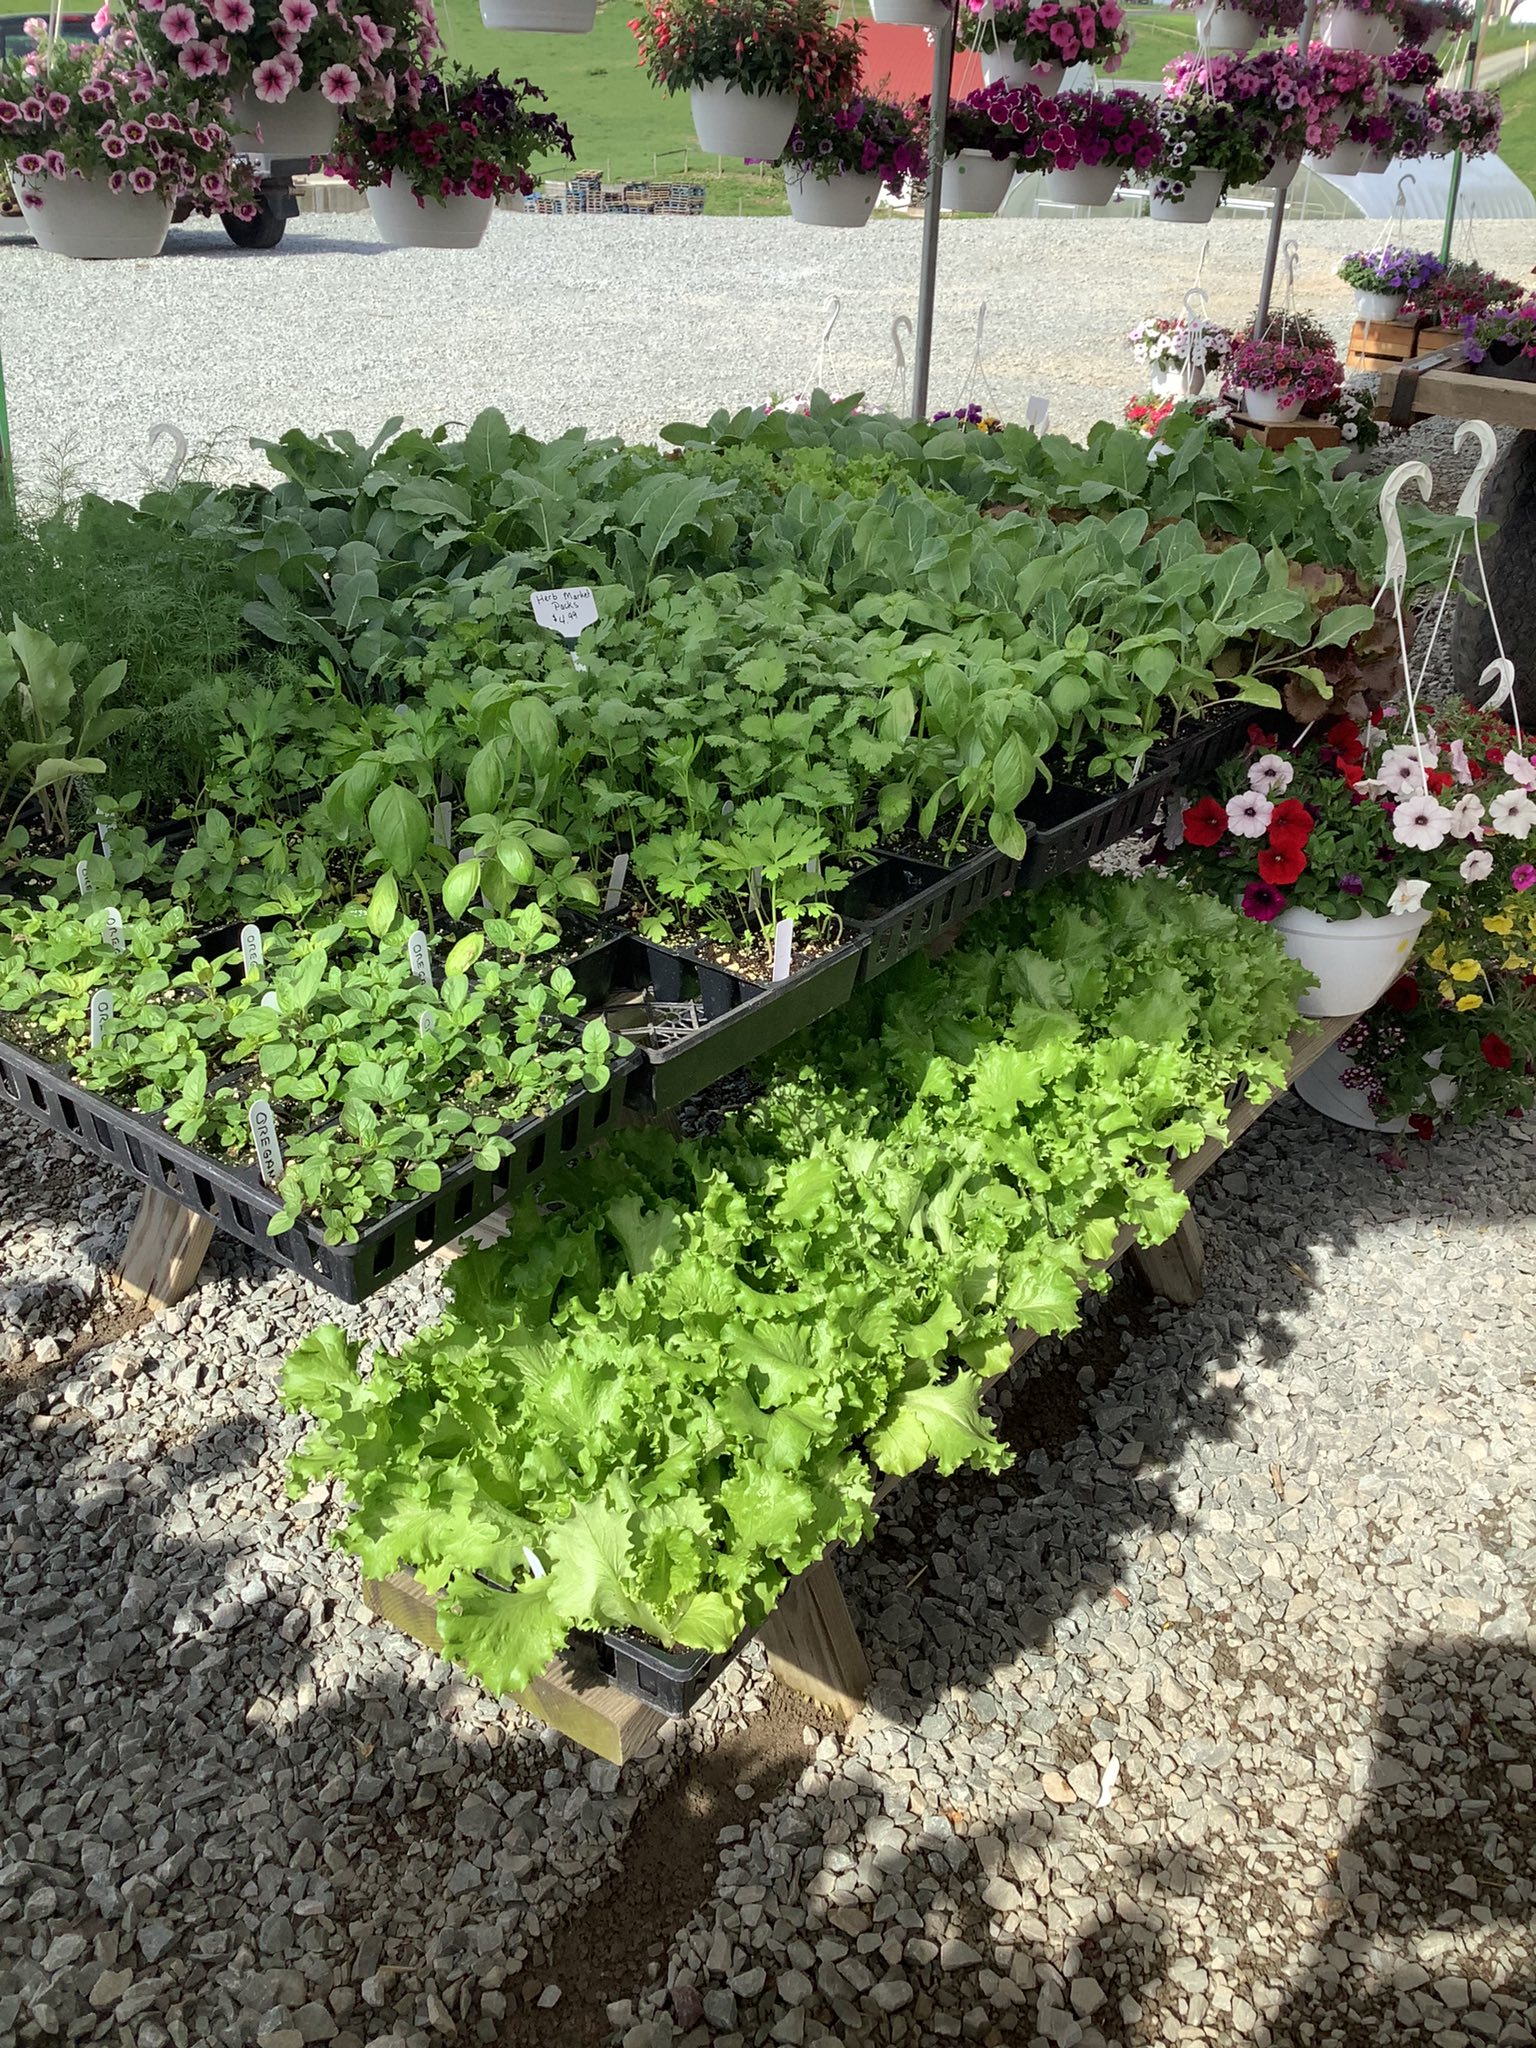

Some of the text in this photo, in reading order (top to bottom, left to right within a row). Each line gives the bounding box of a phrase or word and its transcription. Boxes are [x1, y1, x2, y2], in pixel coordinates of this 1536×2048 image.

[536, 589, 590, 604] Herb Market
[552, 601, 579, 611] Packs
